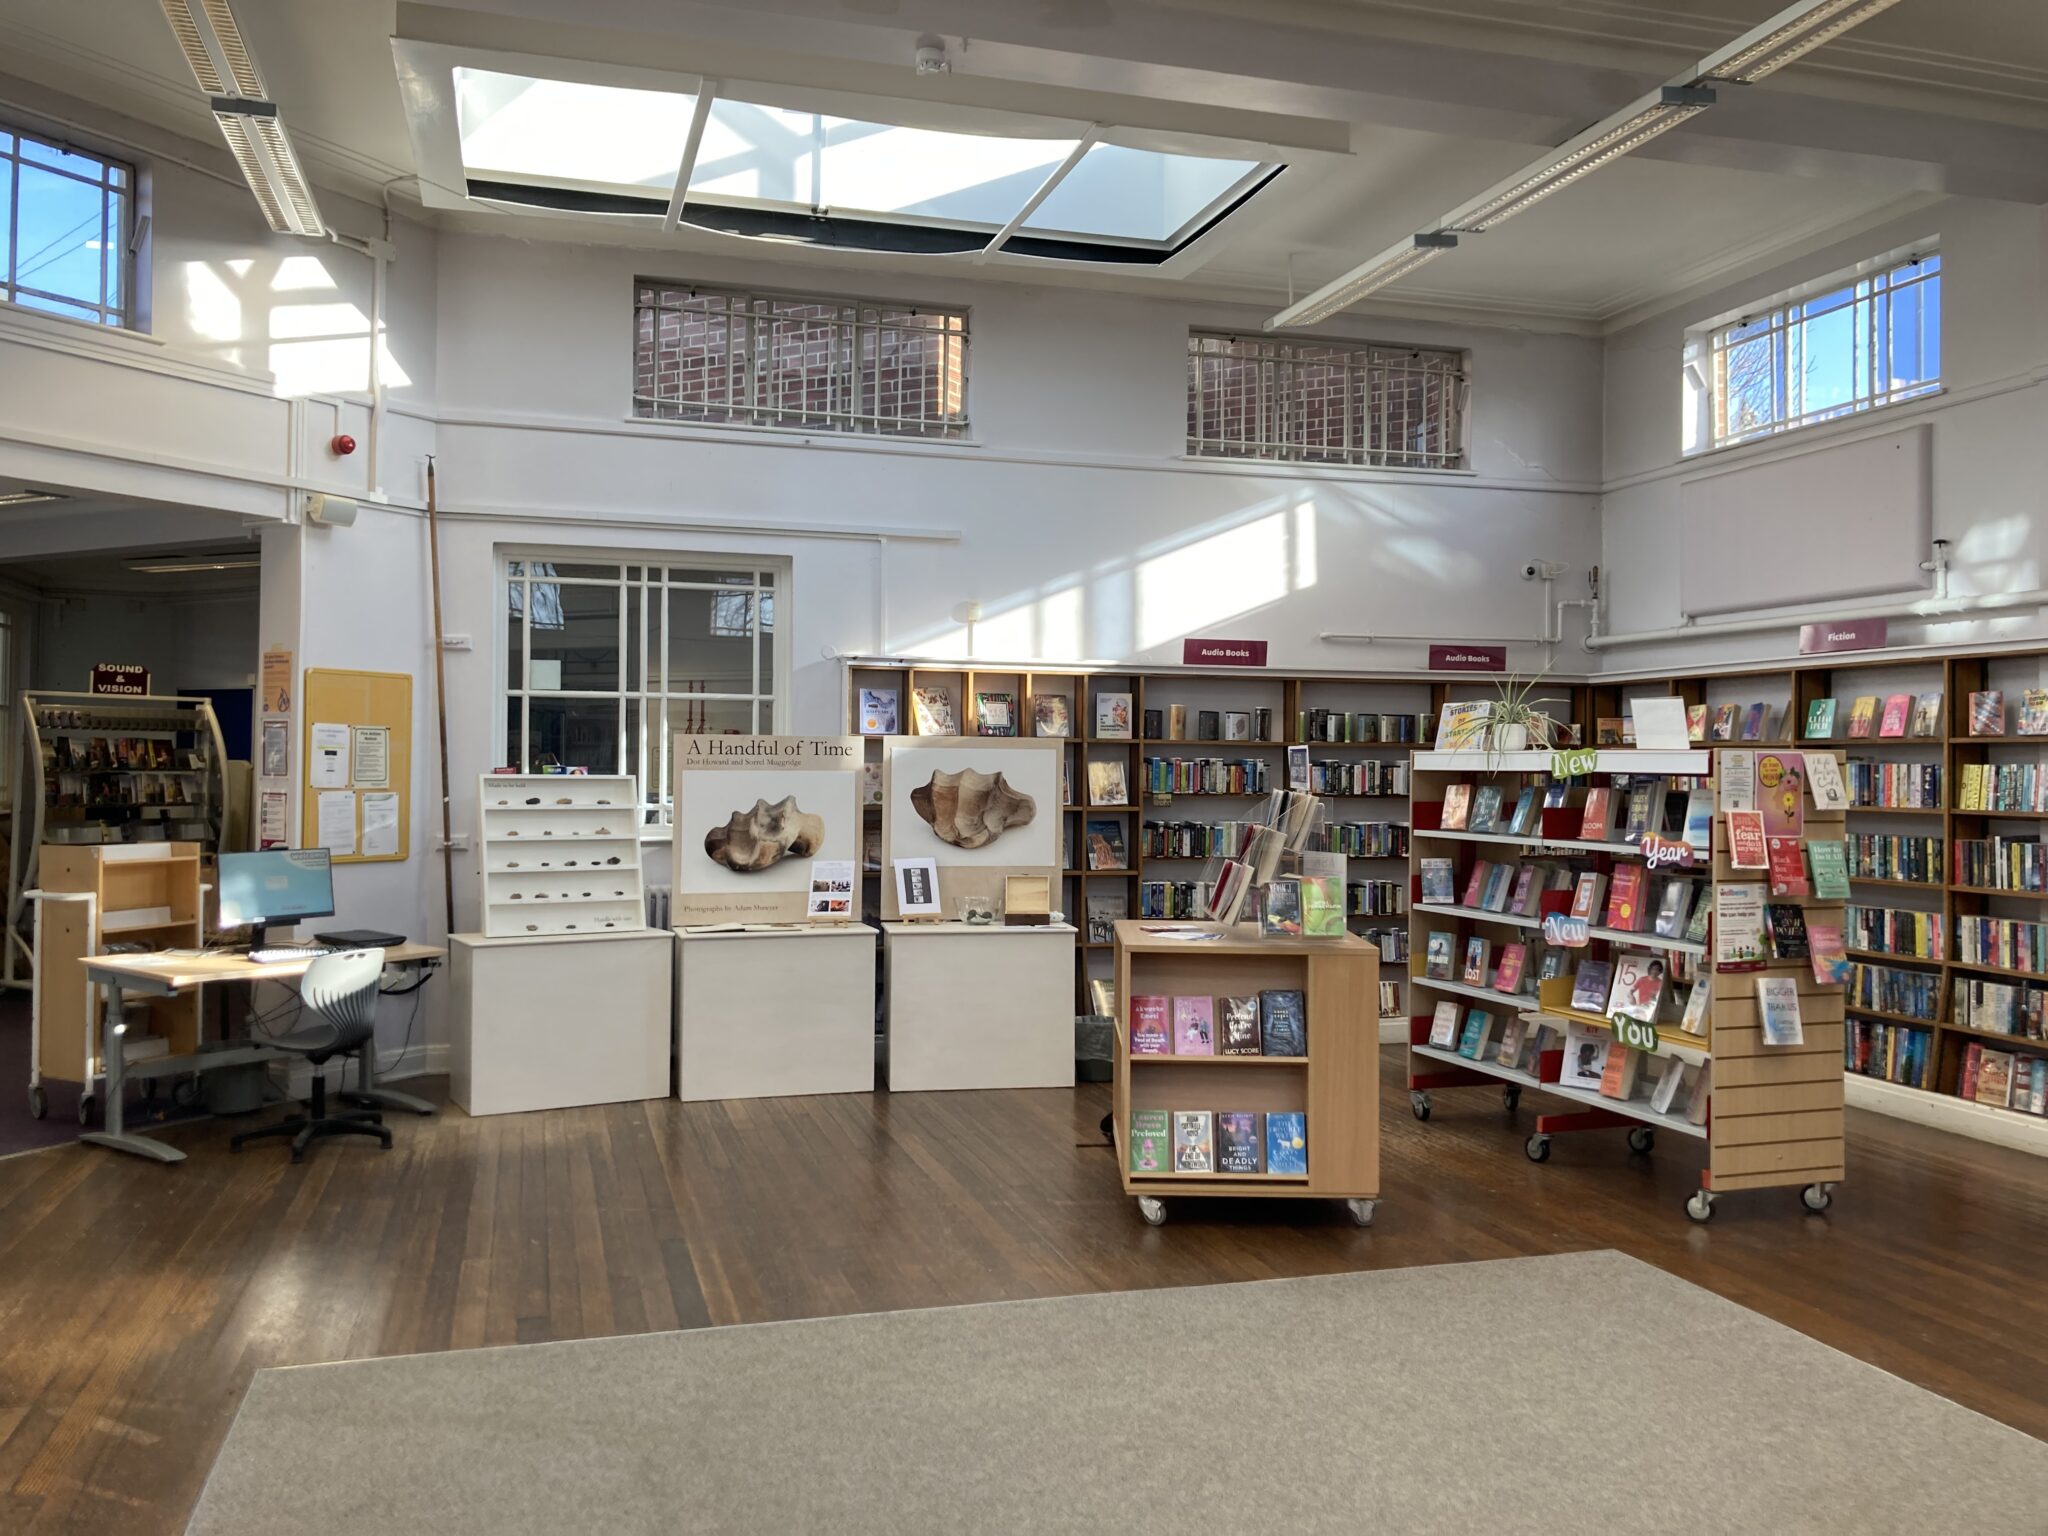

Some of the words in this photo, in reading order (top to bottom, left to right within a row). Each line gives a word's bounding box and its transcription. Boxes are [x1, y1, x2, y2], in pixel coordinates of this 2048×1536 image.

[1827, 631, 1856, 642] Fiction
[1201, 648, 1225, 657] Audio
[1225, 649, 1250, 657] Books
[1445, 654, 1467, 662] Audio
[1467, 655, 1490, 663] Books
[98, 663, 144, 674] SOUND
[115, 674, 126, 683] &
[97, 684, 143, 694] VISION
[1450, 704, 1478, 717] STORIES
[687, 739, 703, 756] A
[708, 739, 779, 756] Handful
[784, 740, 805, 756] of
[810, 740, 853, 756] Time
[702, 758, 730, 766] Howard
[731, 758, 744, 766] and
[1552, 752, 1597, 777] New
[1735, 829, 1761, 840] fear
[1642, 836, 1689, 869] Year
[1542, 916, 1587, 943] New
[1464, 969, 1481, 980] LOST
[1619, 963, 1638, 986] 15
[1766, 987, 1795, 997] BIGGER
[1226, 1012, 1254, 1021] Pretend
[1231, 1032, 1252, 1041] Mine
[1131, 1128, 1166, 1137] Preloved
[1222, 1157, 1258, 1165] DEADLY
